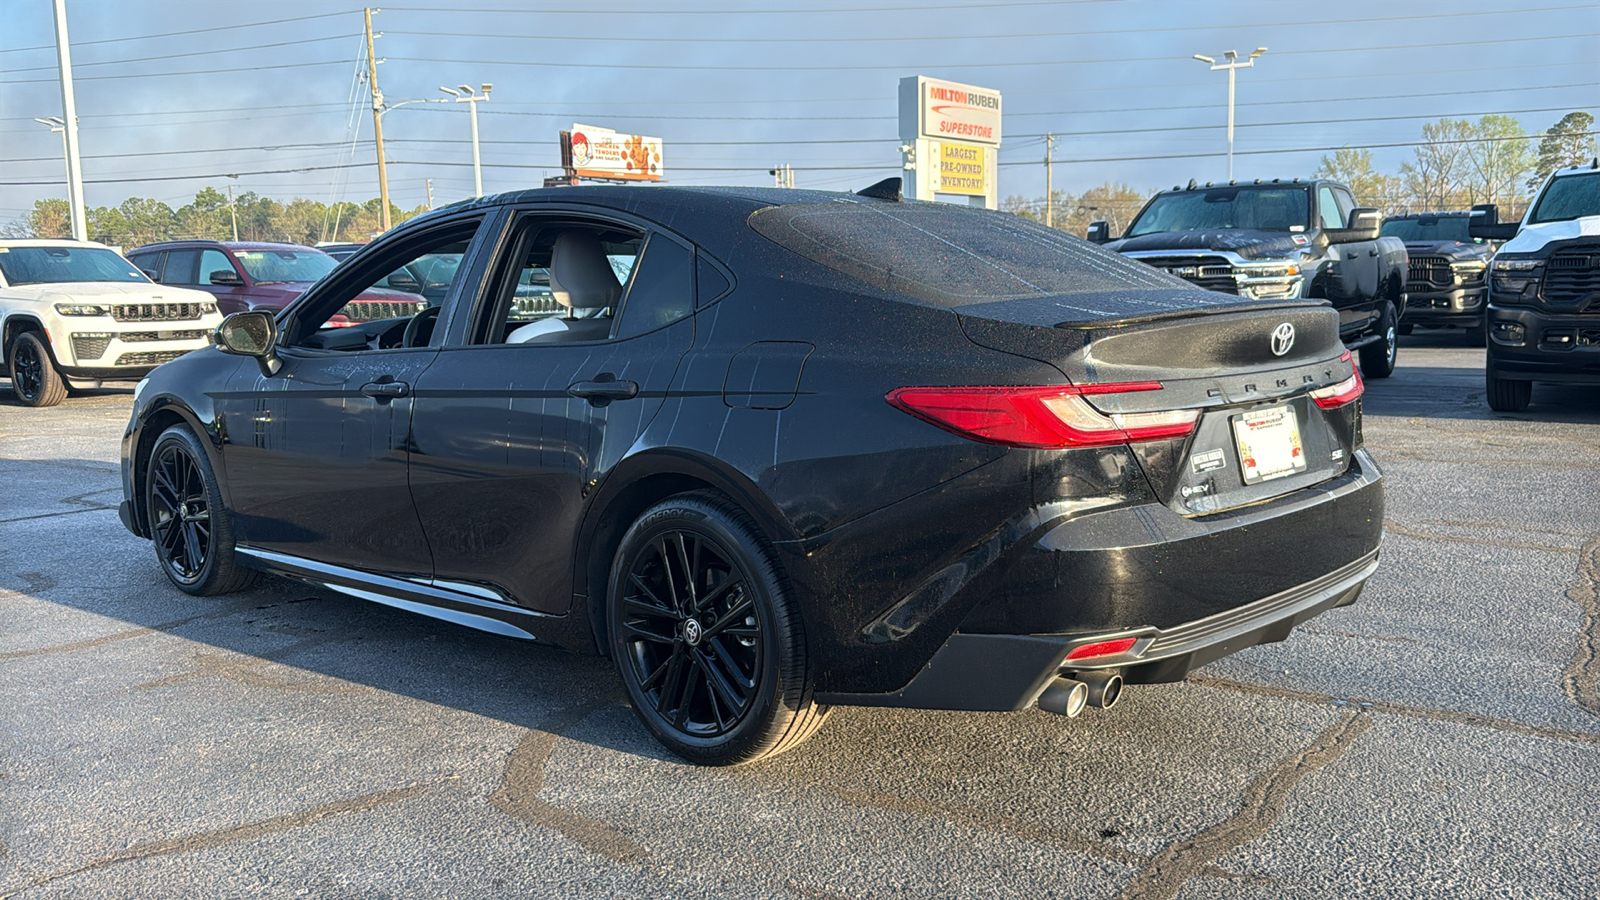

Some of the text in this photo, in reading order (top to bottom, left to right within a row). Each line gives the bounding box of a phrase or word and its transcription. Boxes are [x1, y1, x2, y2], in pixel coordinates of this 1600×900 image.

[930, 86, 999, 110] MILTON RUBEN
[939, 120, 992, 138] SUPERSTORE
[945, 147, 977, 160] LARGEST
[941, 161, 982, 174] PRE-OWNED
[941, 176, 982, 189] NVENTORY!
[1206, 369, 1333, 398] CAMRY
[1331, 449, 1343, 461] SE
